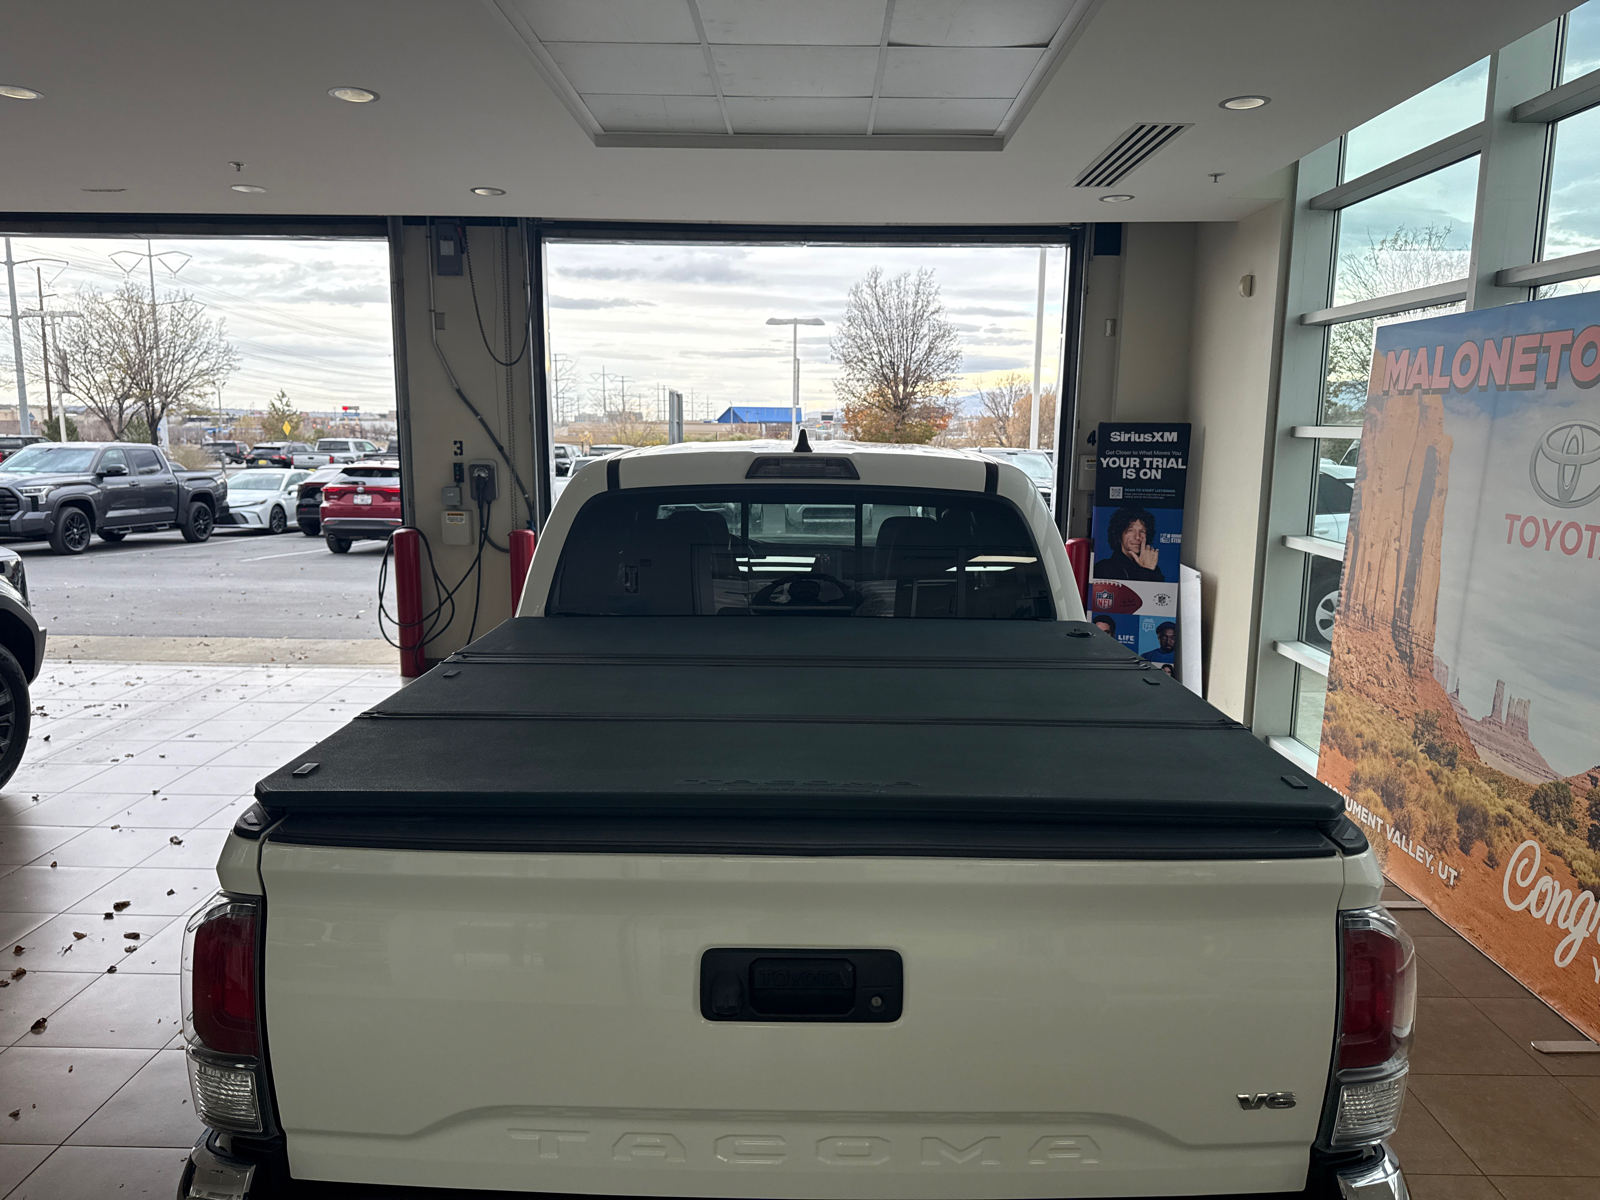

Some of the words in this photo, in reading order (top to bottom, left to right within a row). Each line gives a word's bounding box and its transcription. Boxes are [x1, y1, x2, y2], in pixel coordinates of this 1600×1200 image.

[1086, 430, 1096, 447] 4
[1110, 431, 1178, 442] SiriusXM
[453, 440, 464, 456] 3
[1100, 457, 1140, 468] YOUR
[1143, 457, 1187, 469] TRIAL
[1122, 468, 1136, 479] IS
[1139, 468, 1162, 480] ON
[1504, 513, 1600, 561] TOYOT
[1386, 823, 1435, 875] VALLEY,
[1438, 860, 1458, 886] UT
[760, 969, 848, 987] TOYOTA
[1236, 1091, 1297, 1111] V6
[507, 1127, 1102, 1167] TACOMA
